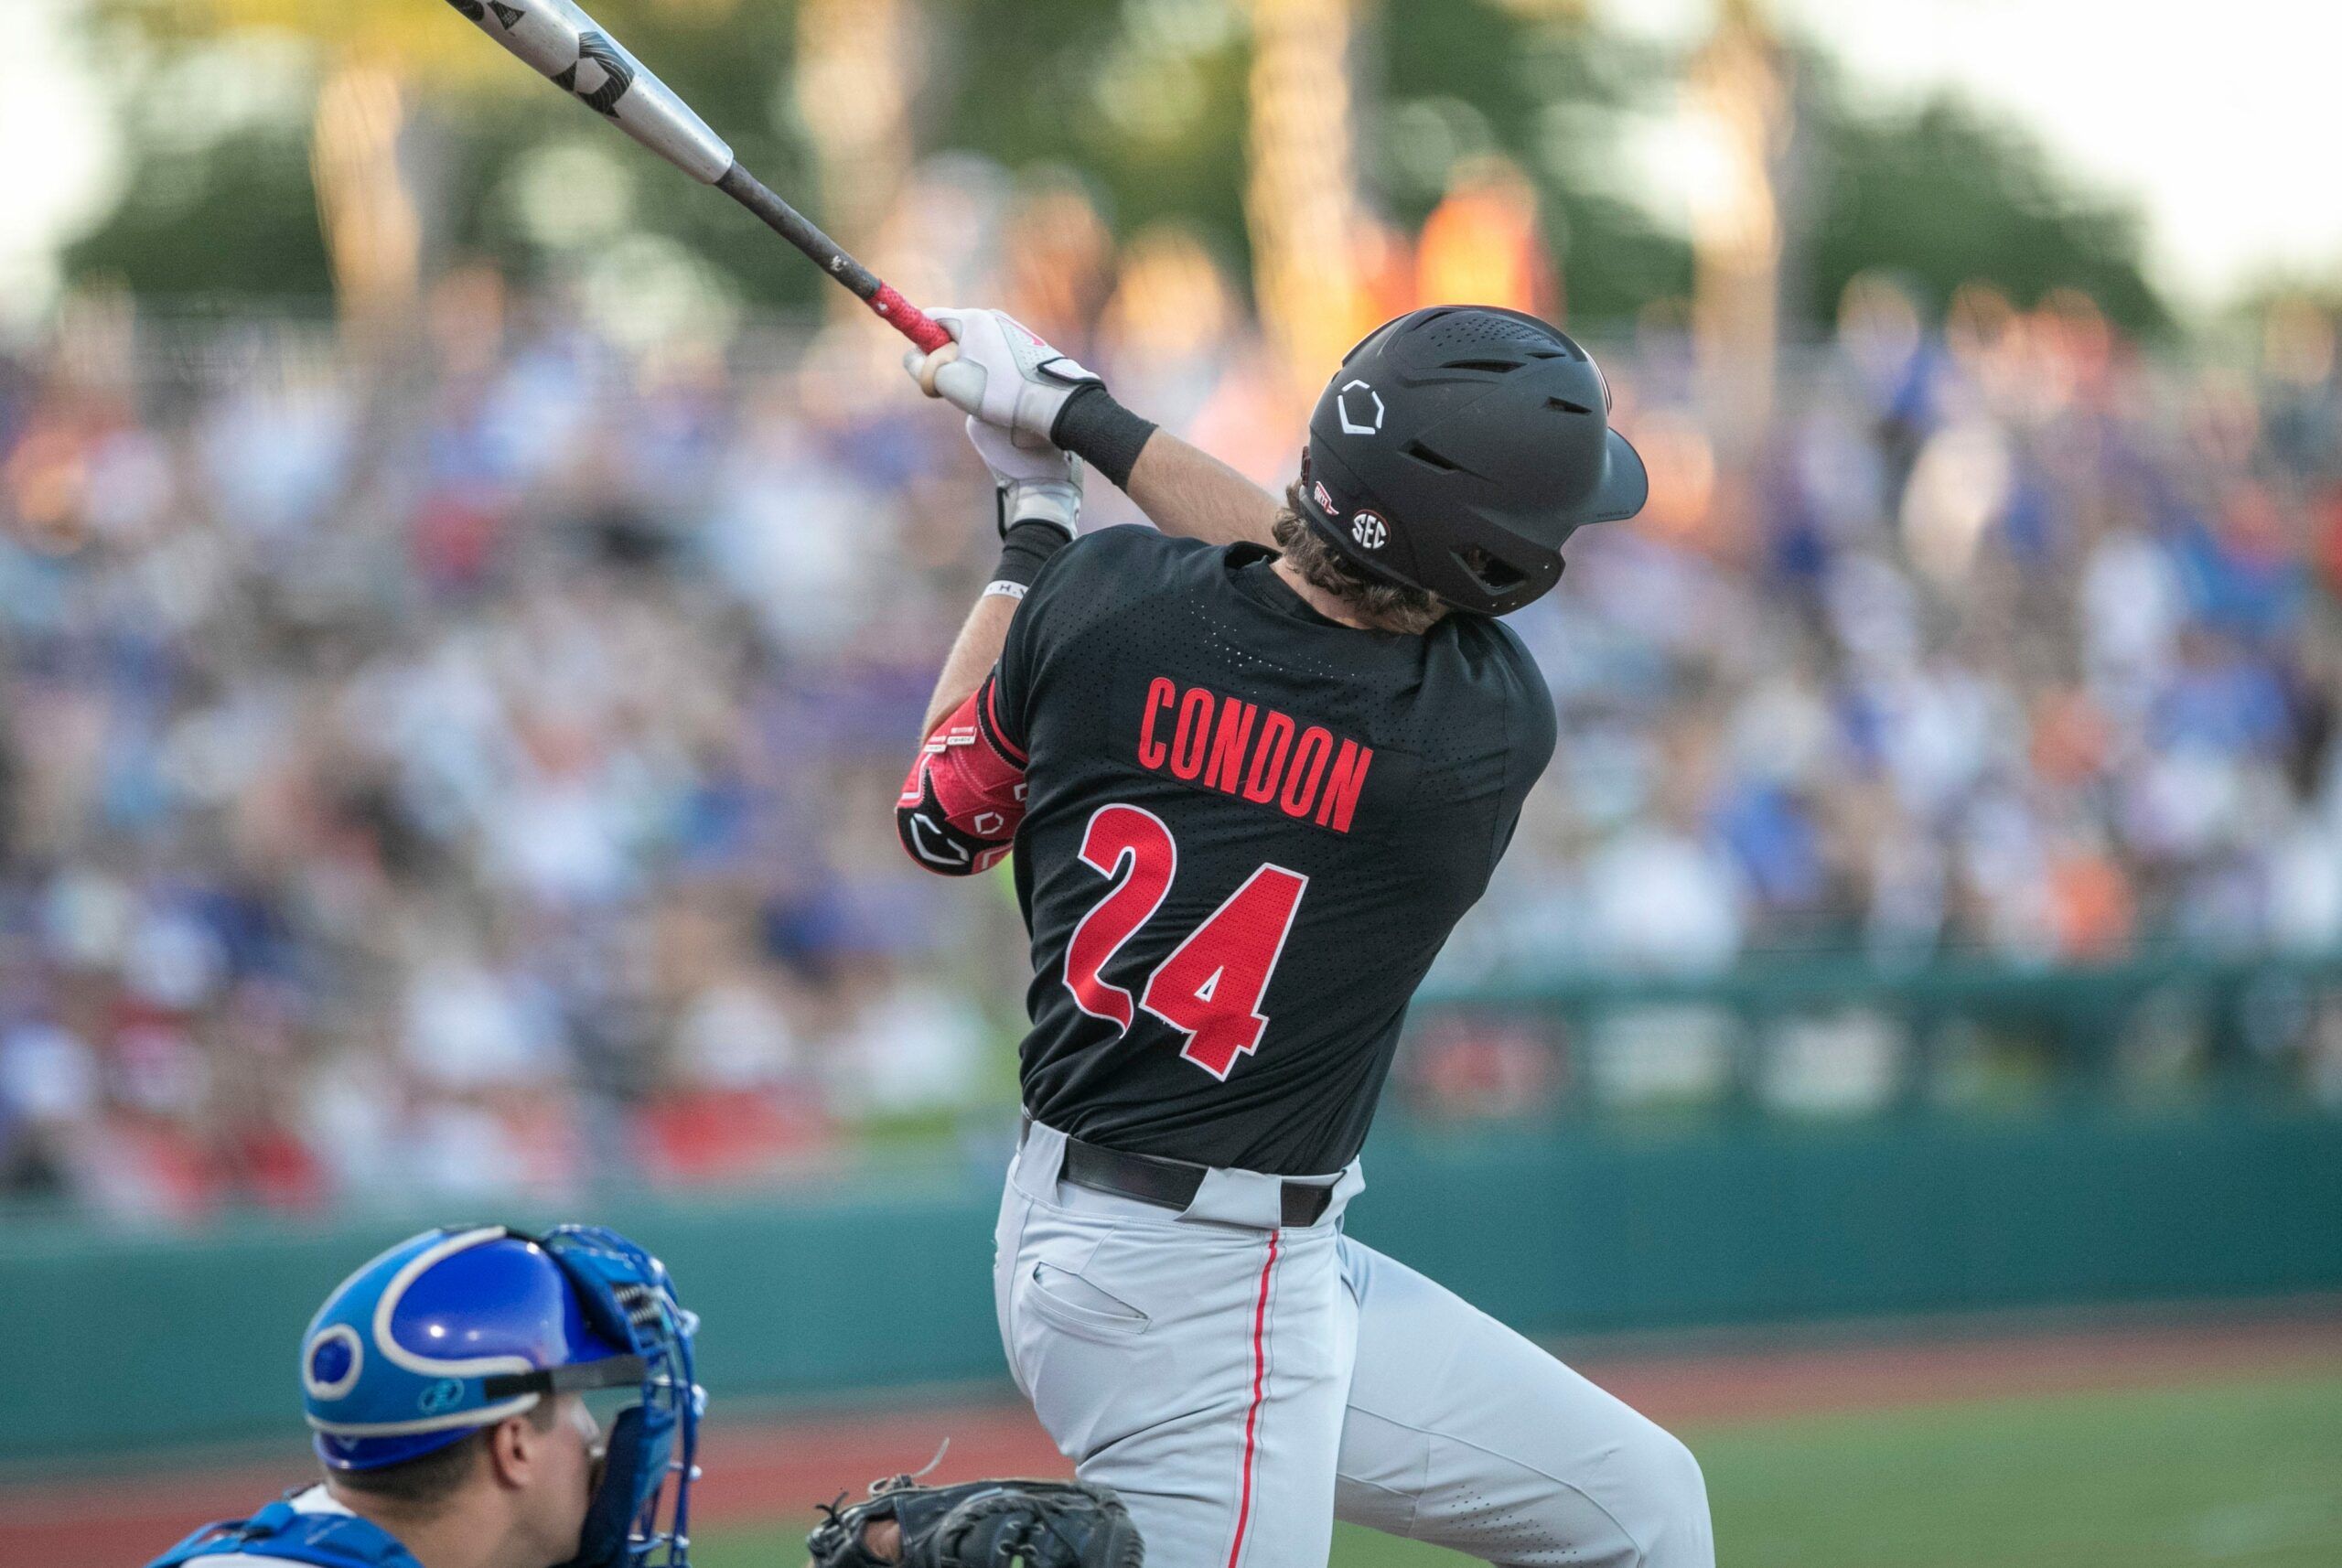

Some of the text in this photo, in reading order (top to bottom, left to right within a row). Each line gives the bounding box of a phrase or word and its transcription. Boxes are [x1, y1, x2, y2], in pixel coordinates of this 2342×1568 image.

[1352, 513, 1387, 549] SEC
[1138, 677, 1373, 833] CONDON
[1062, 803, 1309, 1082] 24
